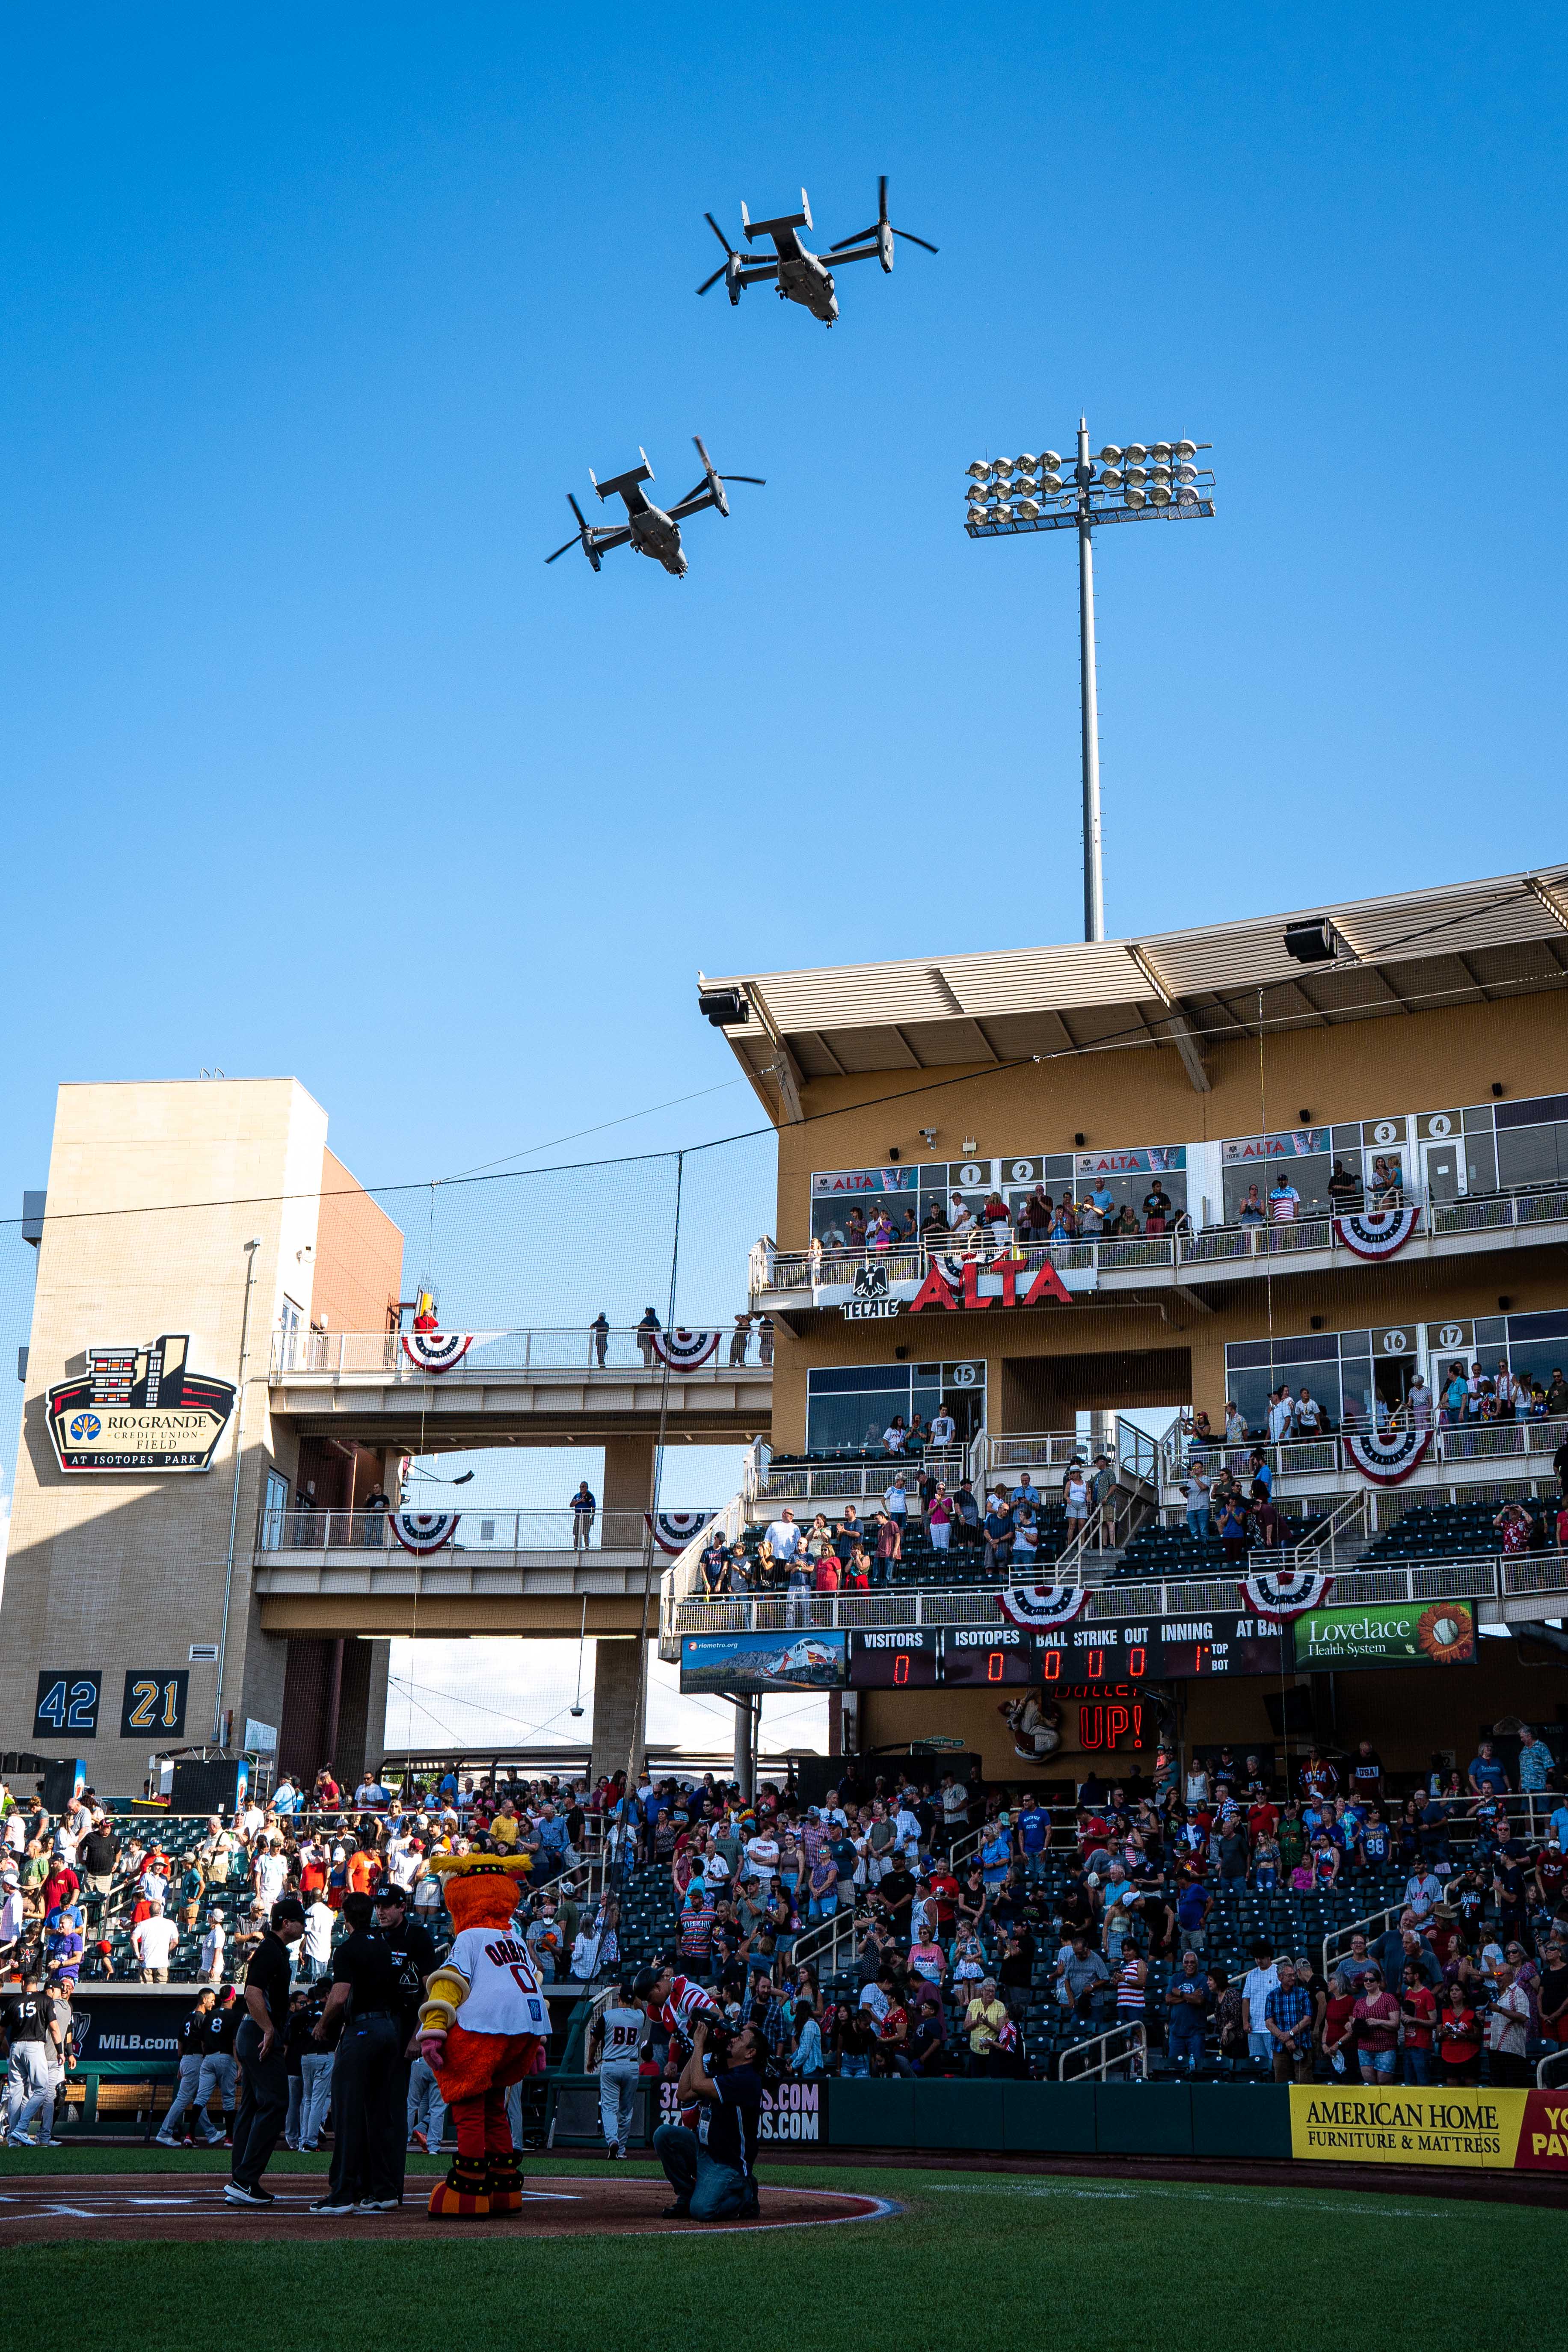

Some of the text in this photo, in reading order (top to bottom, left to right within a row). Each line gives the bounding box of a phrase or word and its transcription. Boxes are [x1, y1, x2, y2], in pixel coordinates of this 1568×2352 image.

[1381, 1126, 1390, 1140] 3
[1435, 1119, 1444, 1132] 4
[1243, 1141, 1286, 1157] ALTA
[1097, 1156, 1140, 1170] ALTA
[968, 1169, 974, 1182] 1
[1020, 1165, 1027, 1178] 2
[833, 1176, 874, 1190] ALTA
[909, 1259, 1073, 1312] ALTA
[839, 1298, 899, 1318] TECATE
[1387, 1335, 1404, 1349] 16
[1443, 1329, 1459, 1344] 17
[958, 1368, 972, 1382] 15
[108, 1416, 206, 1428] RIO GRANDE
[137, 1440, 177, 1449] FIELD
[94, 1455, 154, 1464] ISOTOPES
[165, 1455, 196, 1463] PARK
[1125, 1627, 1149, 1644] OUT
[1161, 1622, 1213, 1641] INNING
[1236, 1620, 1253, 1638] AT
[1309, 1618, 1411, 1643] Lovelace
[864, 1632, 923, 1648] VISITORS
[955, 1630, 1020, 1646] ISOTOPES
[1036, 1631, 1068, 1647] BALL
[1074, 1629, 1117, 1647] STRIKE
[1211, 1644, 1228, 1654] TOP
[1308, 1642, 1386, 1657] Health System
[894, 1656, 909, 1684] 0
[988, 1653, 1004, 1681] 0
[1045, 1651, 1060, 1680] 0
[1088, 1650, 1103, 1677] 0
[1130, 1648, 1145, 1677] 0
[1212, 1659, 1228, 1671] BOT
[39, 1681, 97, 1727] 42
[129, 1681, 178, 1727] 21
[1080, 1705, 1142, 1749] UP!
[1367, 1839, 1384, 1855] 98
[485, 1939, 529, 1967] ORBIT
[510, 1964, 538, 1994] 0
[18, 2001, 37, 2018] 15
[184, 2022, 190, 2036] 3
[211, 2017, 222, 2034] 8
[99, 2035, 178, 2049] MiLB.com
[1306, 2101, 1499, 2130] AMERICAN HOME
[1308, 2131, 1501, 2154] FURNITURE & MATTRESS
